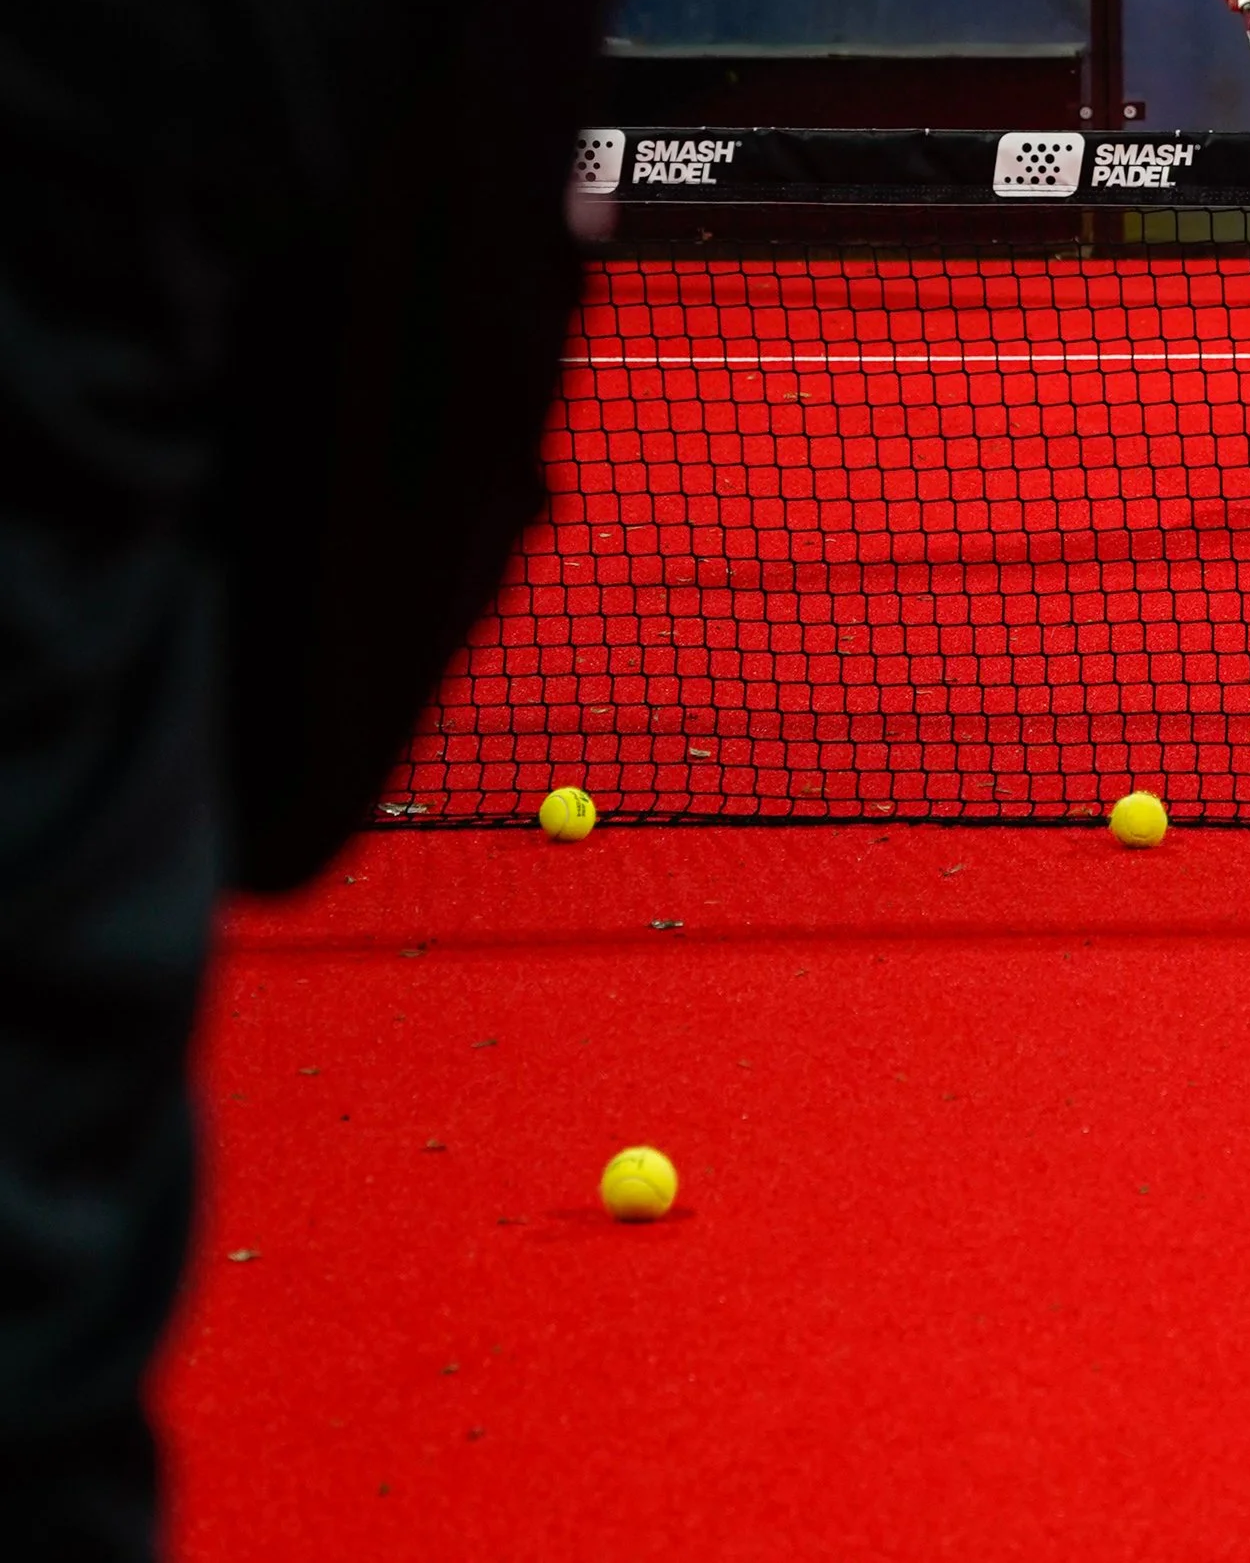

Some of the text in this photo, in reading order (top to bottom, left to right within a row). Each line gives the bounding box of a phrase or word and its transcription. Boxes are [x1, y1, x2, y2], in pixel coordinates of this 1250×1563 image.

[635, 140, 735, 163] SMASH
[1094, 143, 1194, 166] SMASH
[632, 162, 717, 184] PADEL
[1091, 165, 1176, 188] PADEL
